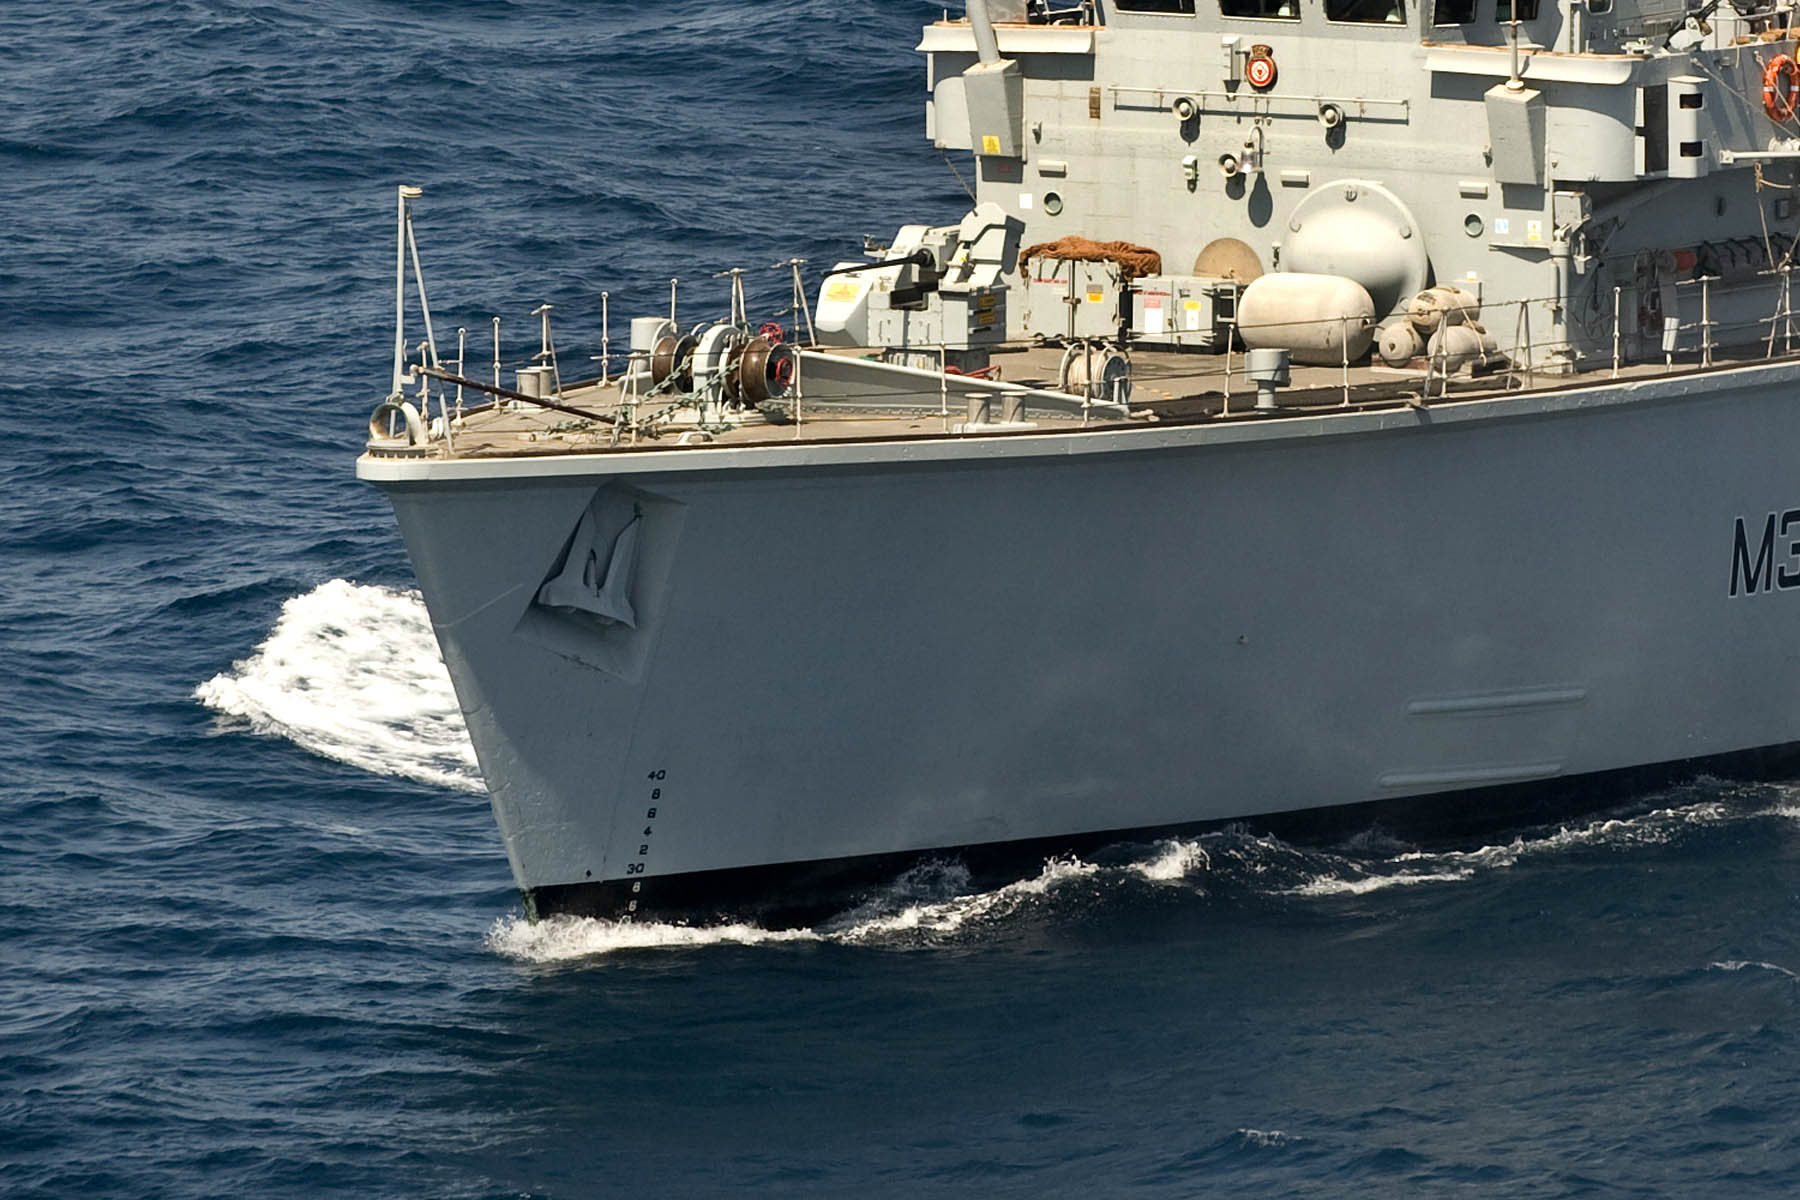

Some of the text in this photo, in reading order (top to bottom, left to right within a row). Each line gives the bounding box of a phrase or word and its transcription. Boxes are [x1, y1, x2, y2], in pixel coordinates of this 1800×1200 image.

[648, 769, 666, 781] 40
[651, 788, 661, 800] 8
[647, 807, 657, 819] 6
[643, 826, 652, 836] 4
[639, 844, 649, 855] 2
[626, 863, 645, 875] 30
[632, 881, 641, 893] 8
